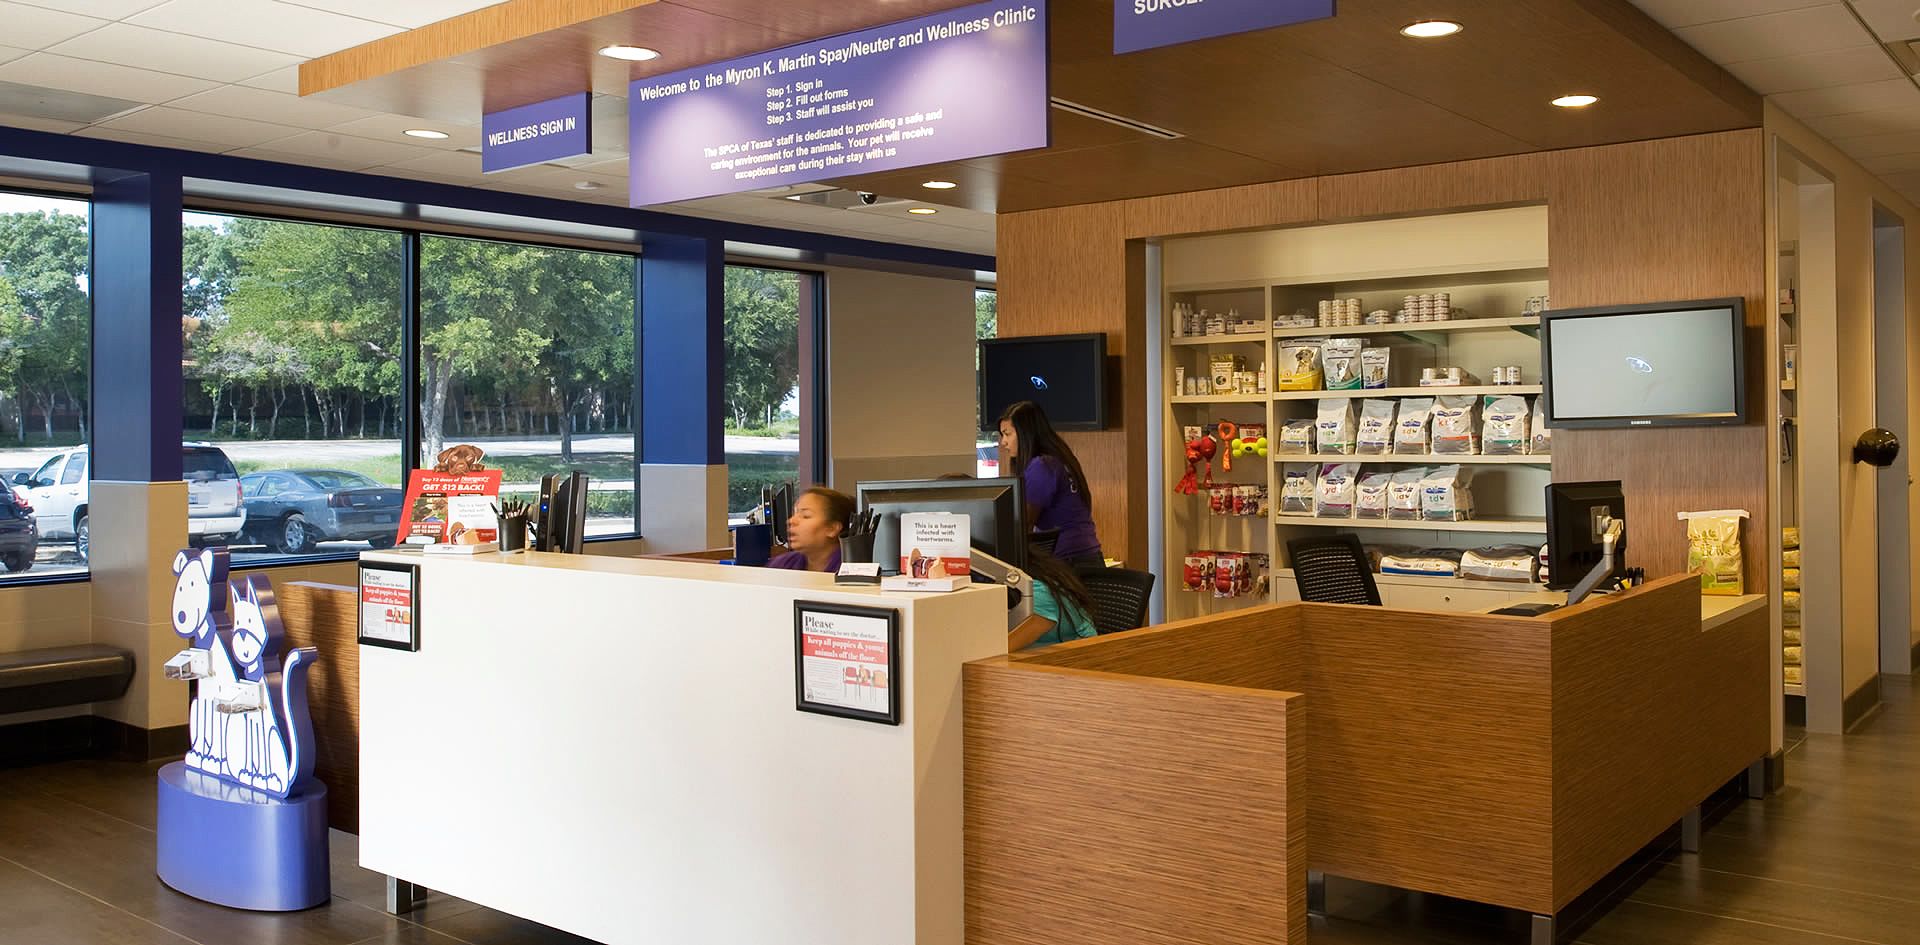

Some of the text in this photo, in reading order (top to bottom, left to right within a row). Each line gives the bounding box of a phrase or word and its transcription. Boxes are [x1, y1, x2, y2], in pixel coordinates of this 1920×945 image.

[640, 6, 1036, 101] Welcome to the Myron K. Martin Spay/Neuter and Wellness Clinic
[766, 78, 823, 98] Step 1. Sign in
[766, 88, 849, 112] Step 2. Fill out forms
[766, 98, 874, 126] Step 3. Staff will assist you
[489, 117, 576, 147] WELLNESS SIGN IN
[704, 148, 718, 158] The
[718, 144, 740, 156] SPCA
[741, 142, 749, 151] of
[776, 134, 794, 146] staff
[796, 133, 803, 143] is
[804, 126, 844, 141] dedicated
[846, 125, 854, 135] to
[856, 118, 896, 135] providing
[898, 118, 903, 126] a
[905, 112, 924, 125] safe
[926, 108, 943, 120] and
[711, 126, 934, 171] caring environment for the animals. Your pet will receive
[735, 148, 896, 180] exceptional care during their stay with us
[805, 616, 834, 629] Please
[808, 636, 823, 646] Keep
[832, 641, 856, 649] puppies
[815, 649, 838, 657] animals
[848, 652, 858, 660] the
[860, 653, 877, 662] floor.
